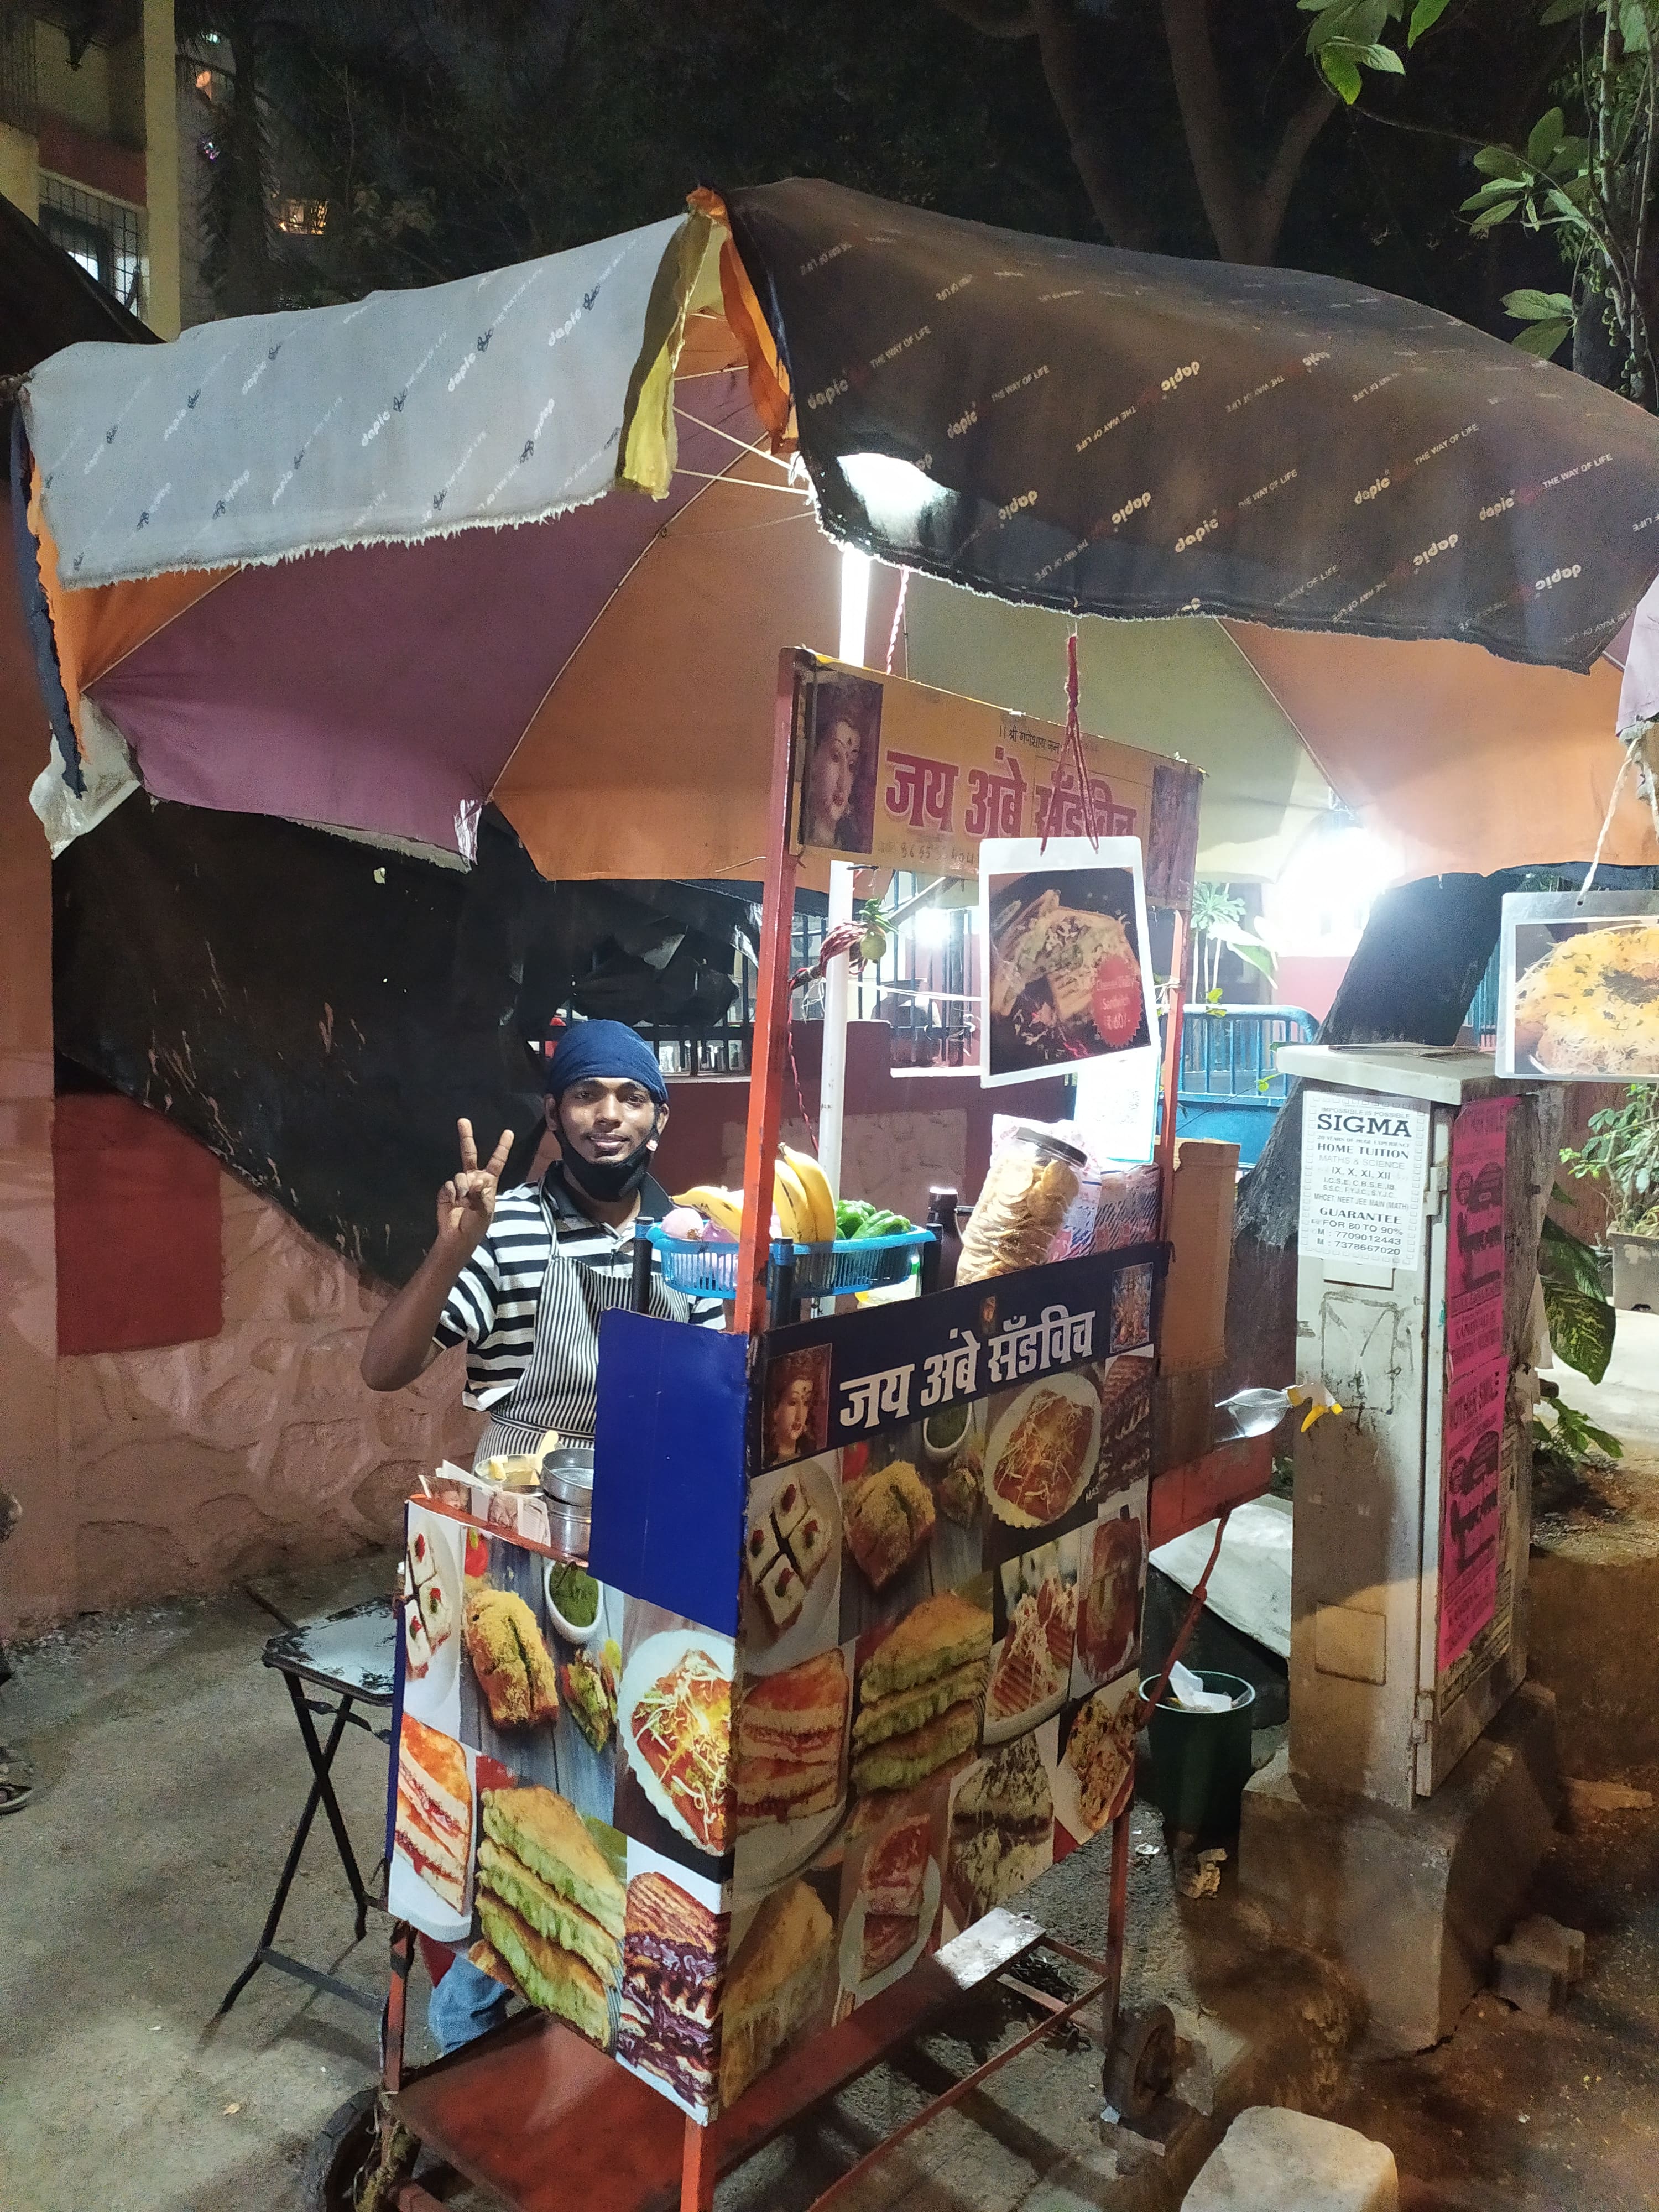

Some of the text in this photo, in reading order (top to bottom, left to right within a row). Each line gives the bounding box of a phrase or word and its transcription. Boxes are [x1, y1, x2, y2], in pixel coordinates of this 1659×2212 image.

[549, 309, 582, 347] dapic
[448, 353, 476, 392] dapic
[808, 326, 931, 409] dapic THE WAY OF LIFE
[1075, 361, 1200, 453] dapic THE WAY OF LIFE
[362, 411, 390, 447] dapic
[947, 410, 977, 439] dapic
[1354, 423, 1479, 505] dapic THE WAY OF LIFE
[1542, 476, 1561, 489] THE
[1561, 467, 1580, 481] WAY
[1580, 461, 1593, 472] OF
[1593, 453, 1613, 467] LIFE
[998, 490, 1037, 520] dapic
[1112, 492, 1151, 524] dapic
[1175, 469, 1298, 553] dapic THE WAY OF LIFE
[1632, 517, 1652, 531] LIFE
[1413, 534, 1458, 566] dapic
[1535, 564, 1582, 590] dapic
[886, 750, 959, 832] जय
[965, 745, 1027, 837] अंबे
[1317, 1114, 1412, 1138] SIGMA
[1318, 1142, 1408, 1159] HOME TUITION
[1319, 1154, 1351, 1165] MATHS
[1362, 1159, 1405, 1169] SCIENCE
[1378, 1171, 1390, 1180] XII
[1319, 1207, 1402, 1224] GUARANTEE
[1323, 1219, 1345, 1228] FOR
[1363, 1224, 1378, 1232] TO
[1381, 1227, 1404, 1235] 90%
[1334, 1230, 1401, 1245] 7709012443
[1334, 1240, 1401, 1255] 7378667020
[839, 1363, 915, 1428] जय
[920, 1328, 980, 1407] अंबे
